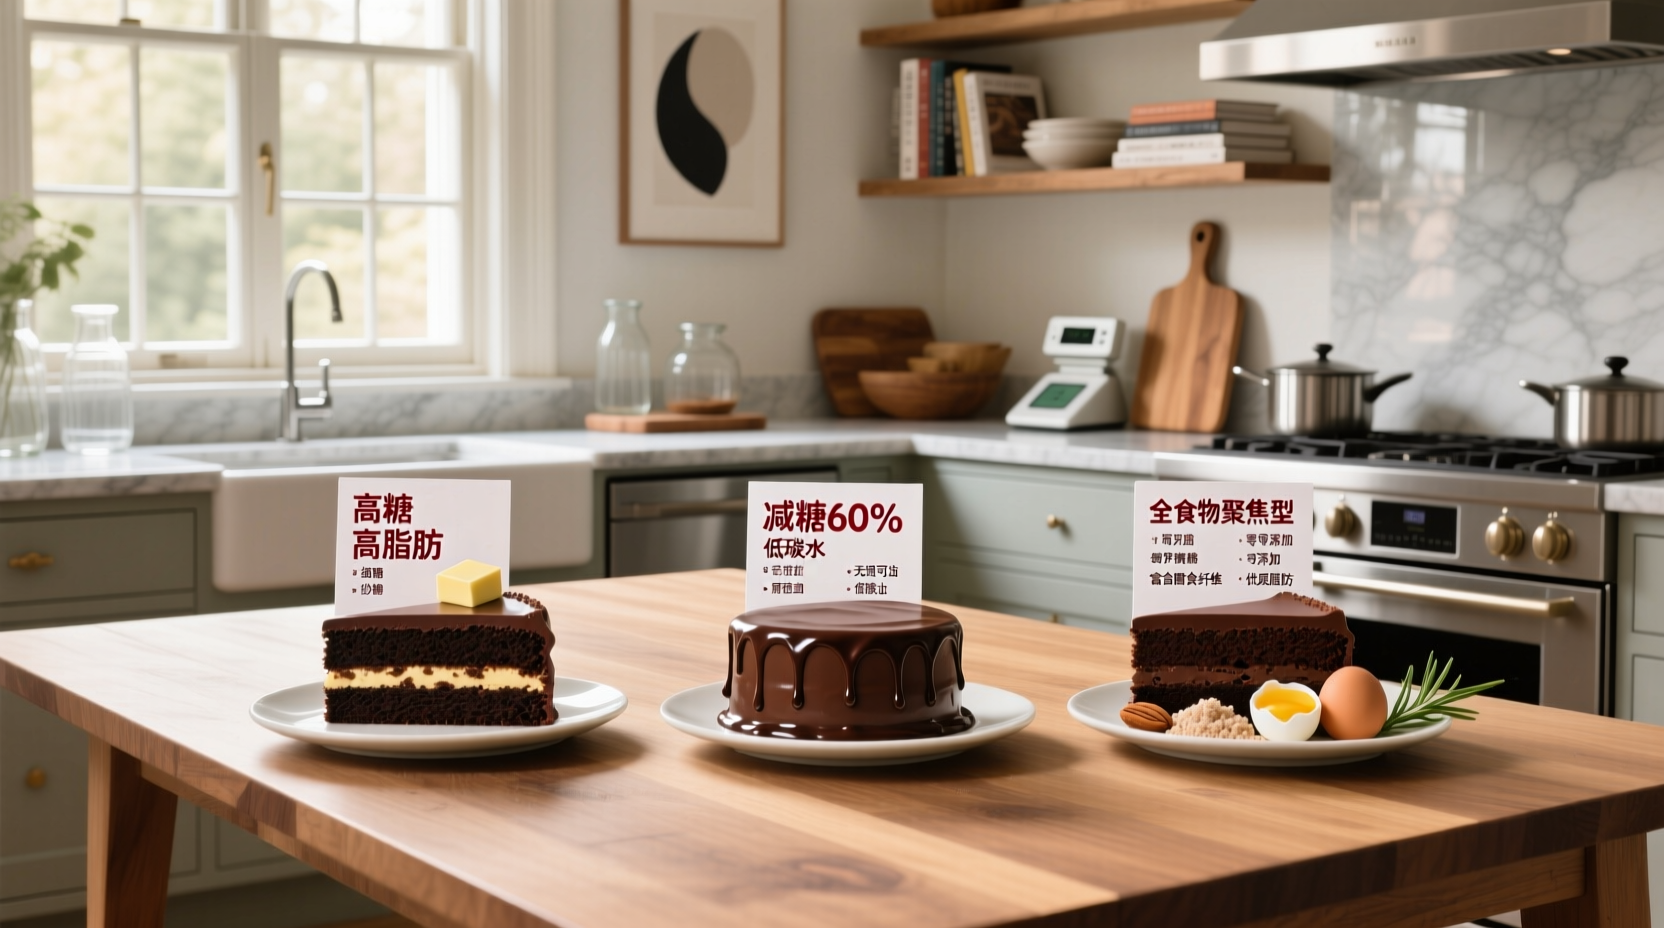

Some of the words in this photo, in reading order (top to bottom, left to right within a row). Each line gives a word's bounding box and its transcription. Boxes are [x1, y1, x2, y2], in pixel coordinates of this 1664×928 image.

[354, 493, 413, 524] 高糖
[763, 500, 902, 533] 减糖60%
[1150, 498, 1294, 525] 全食物聚焦型
[353, 528, 443, 560] 高脂肪
